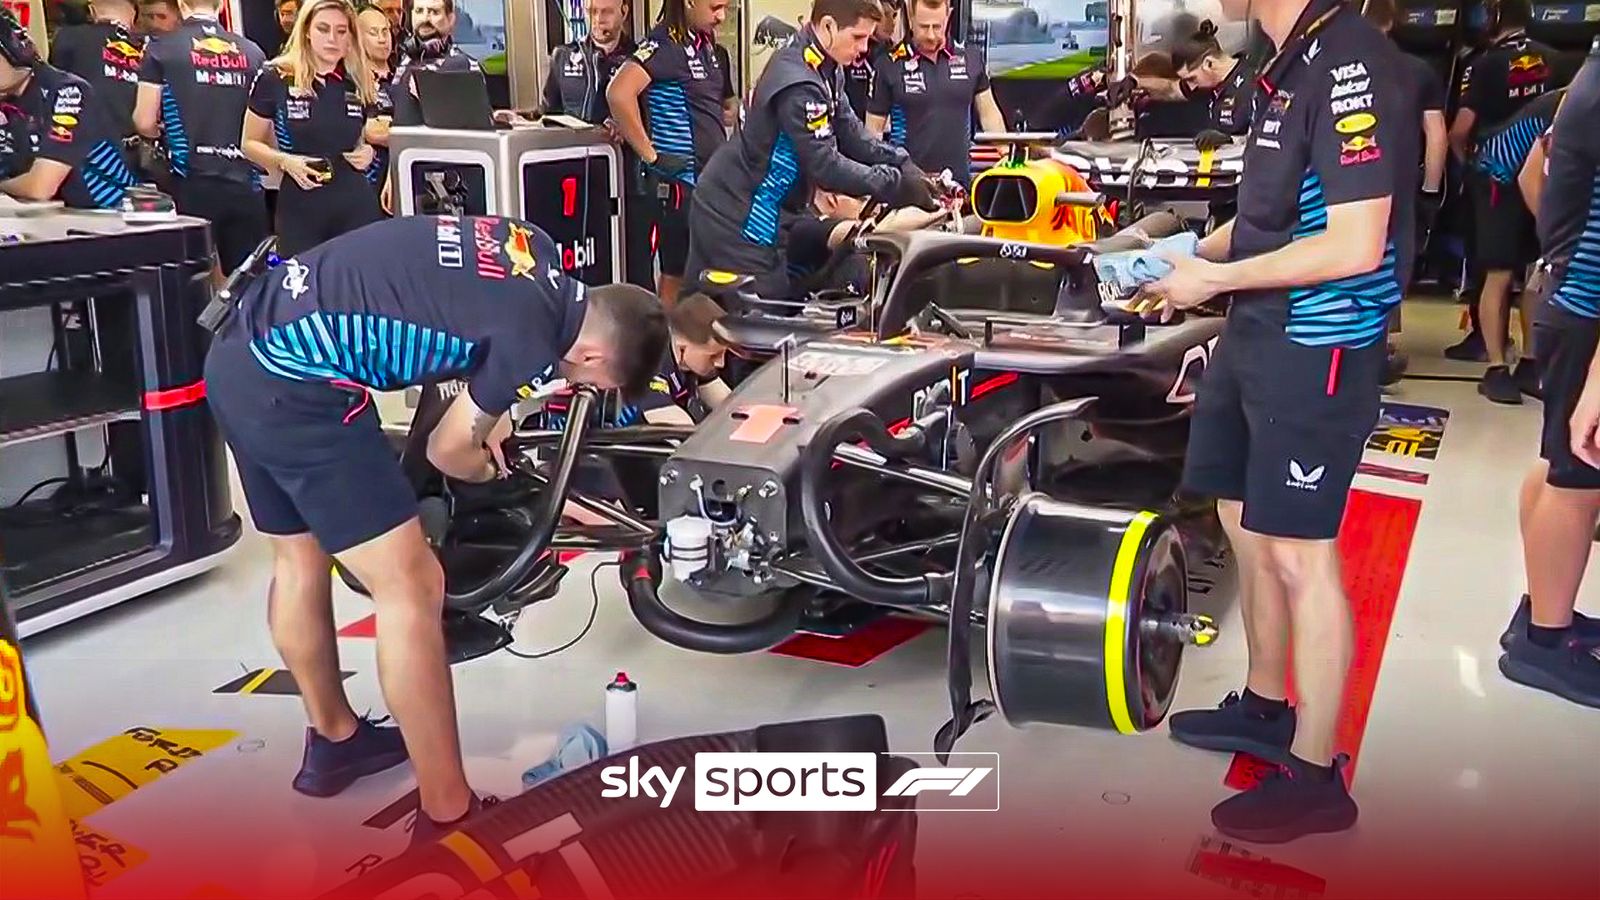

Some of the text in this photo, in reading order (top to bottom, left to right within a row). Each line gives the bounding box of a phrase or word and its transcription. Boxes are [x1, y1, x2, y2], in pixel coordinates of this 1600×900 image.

[190, 51, 248, 69] Red Bull
[1329, 62, 1368, 82] VISA
